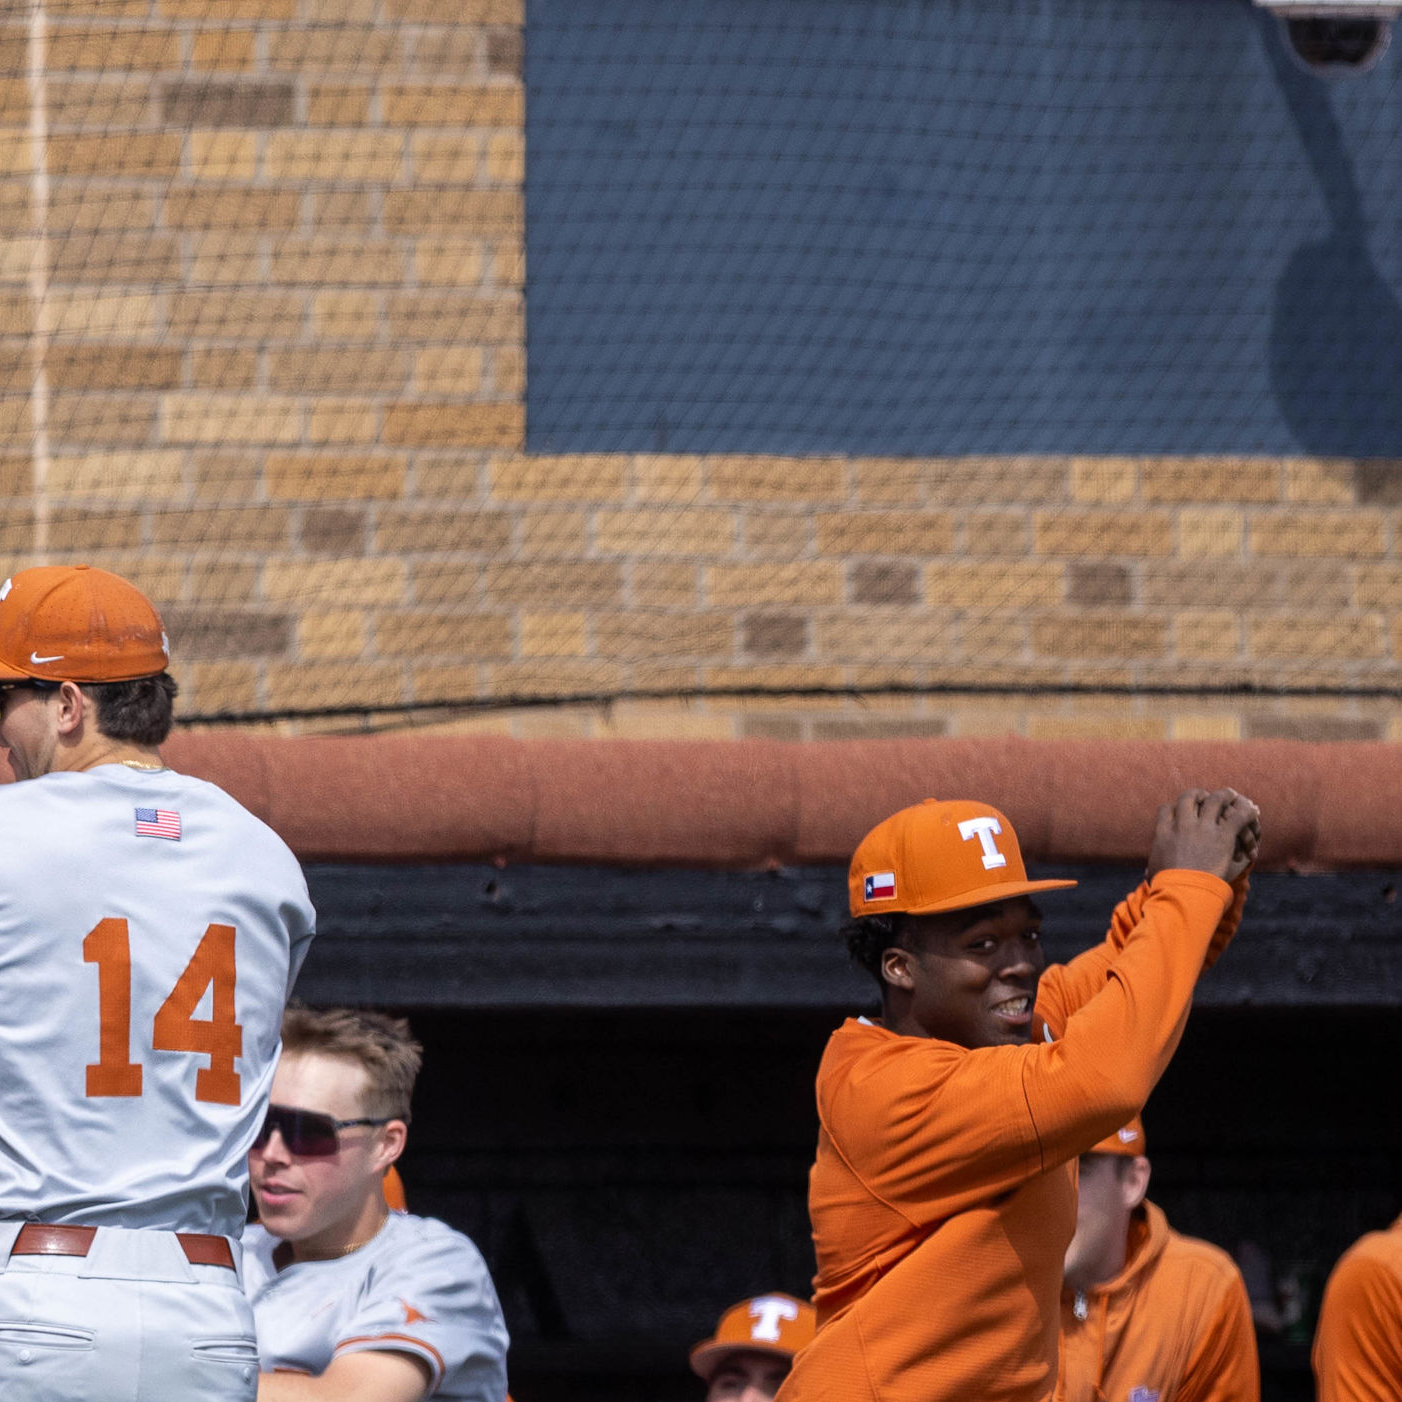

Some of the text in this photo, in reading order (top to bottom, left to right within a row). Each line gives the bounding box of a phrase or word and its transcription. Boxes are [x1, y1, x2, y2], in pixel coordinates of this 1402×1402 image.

[957, 816, 1007, 870] T
[82, 917, 243, 1107] 14
[748, 1296, 799, 1343] T
